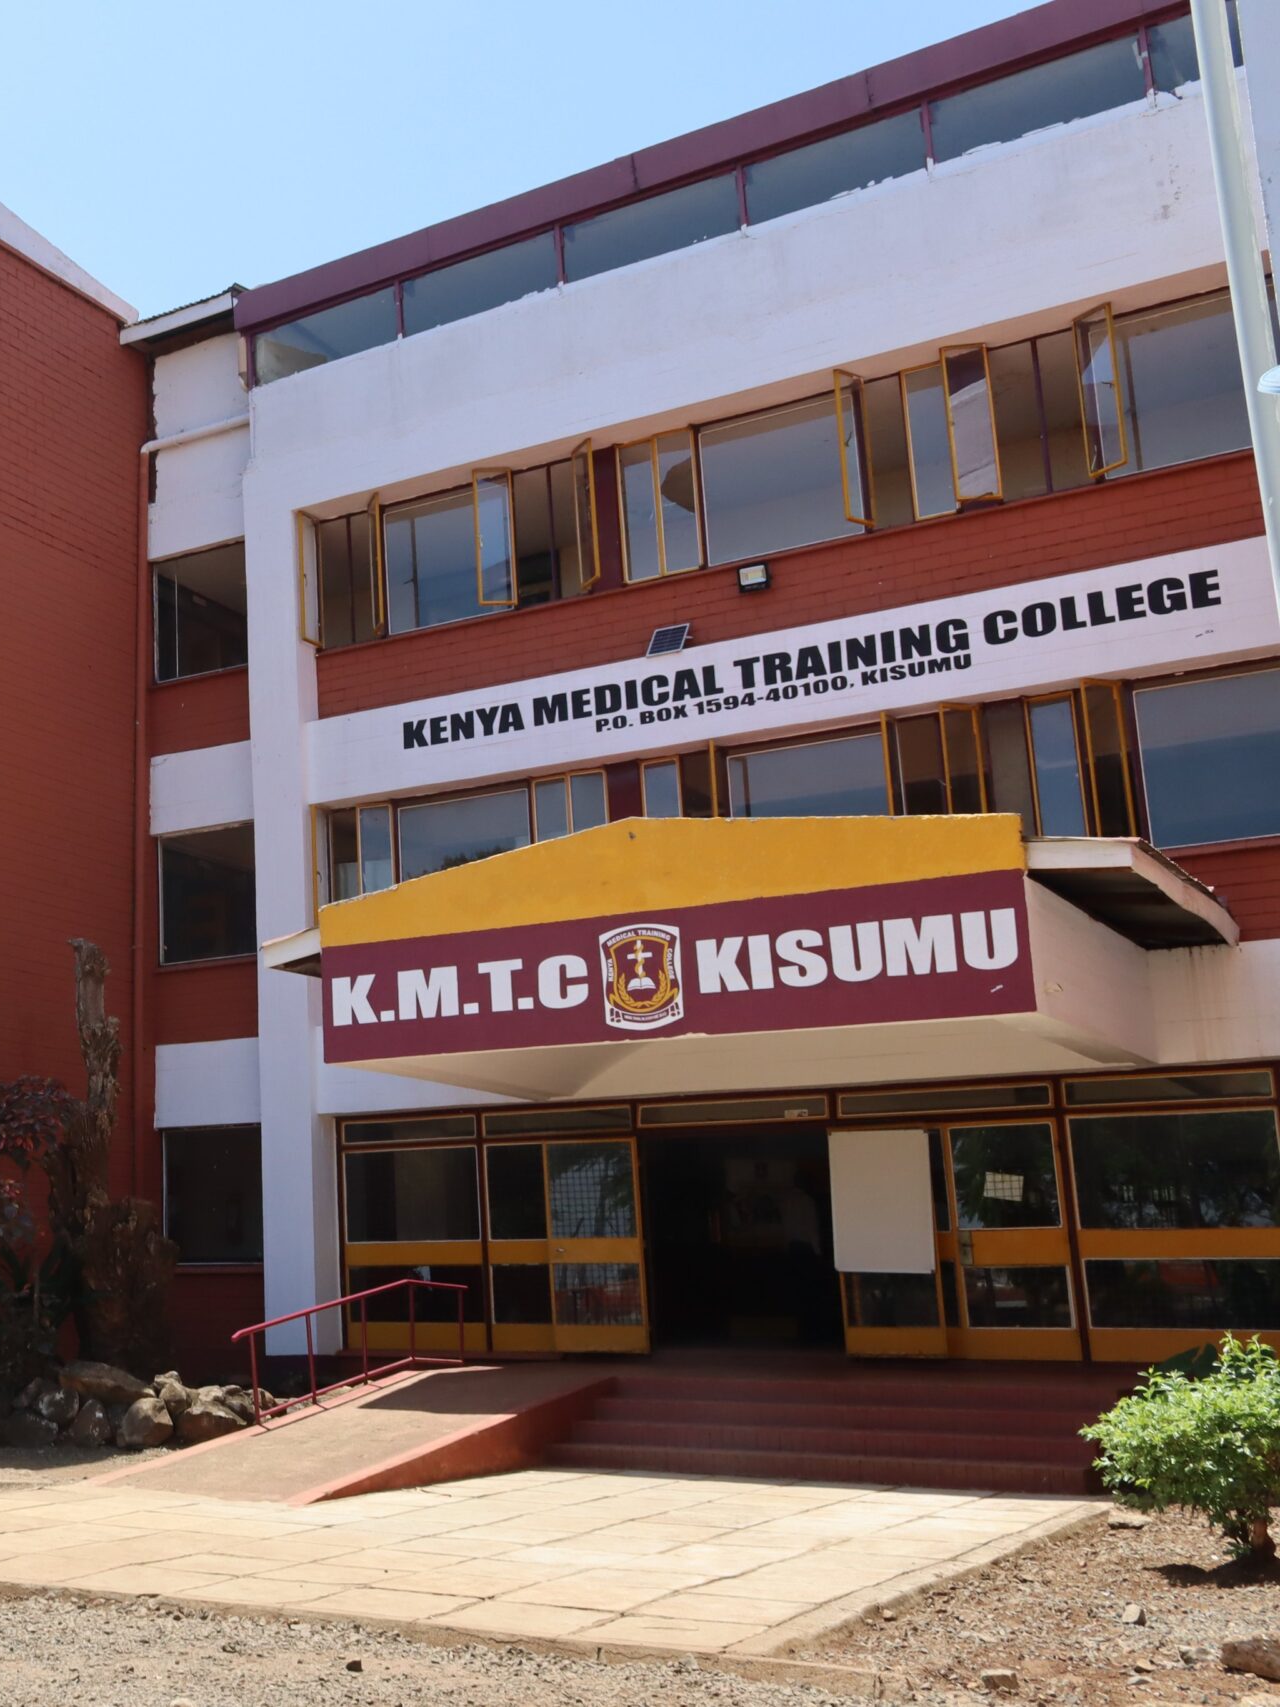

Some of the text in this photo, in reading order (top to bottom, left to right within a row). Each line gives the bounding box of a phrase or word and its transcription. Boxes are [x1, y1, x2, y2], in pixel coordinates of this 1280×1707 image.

[403, 569, 1222, 750] KENYA MEDICAL TRAINING COLLEGE
[595, 715, 634, 733] P.O.
[639, 704, 689, 725] BOX
[860, 652, 972, 686] KISUMU
[331, 906, 1019, 1027] K.M.T.C KISUMU
[606, 929, 676, 982] KENYA MEDICAL TRAINING COLLEGE
